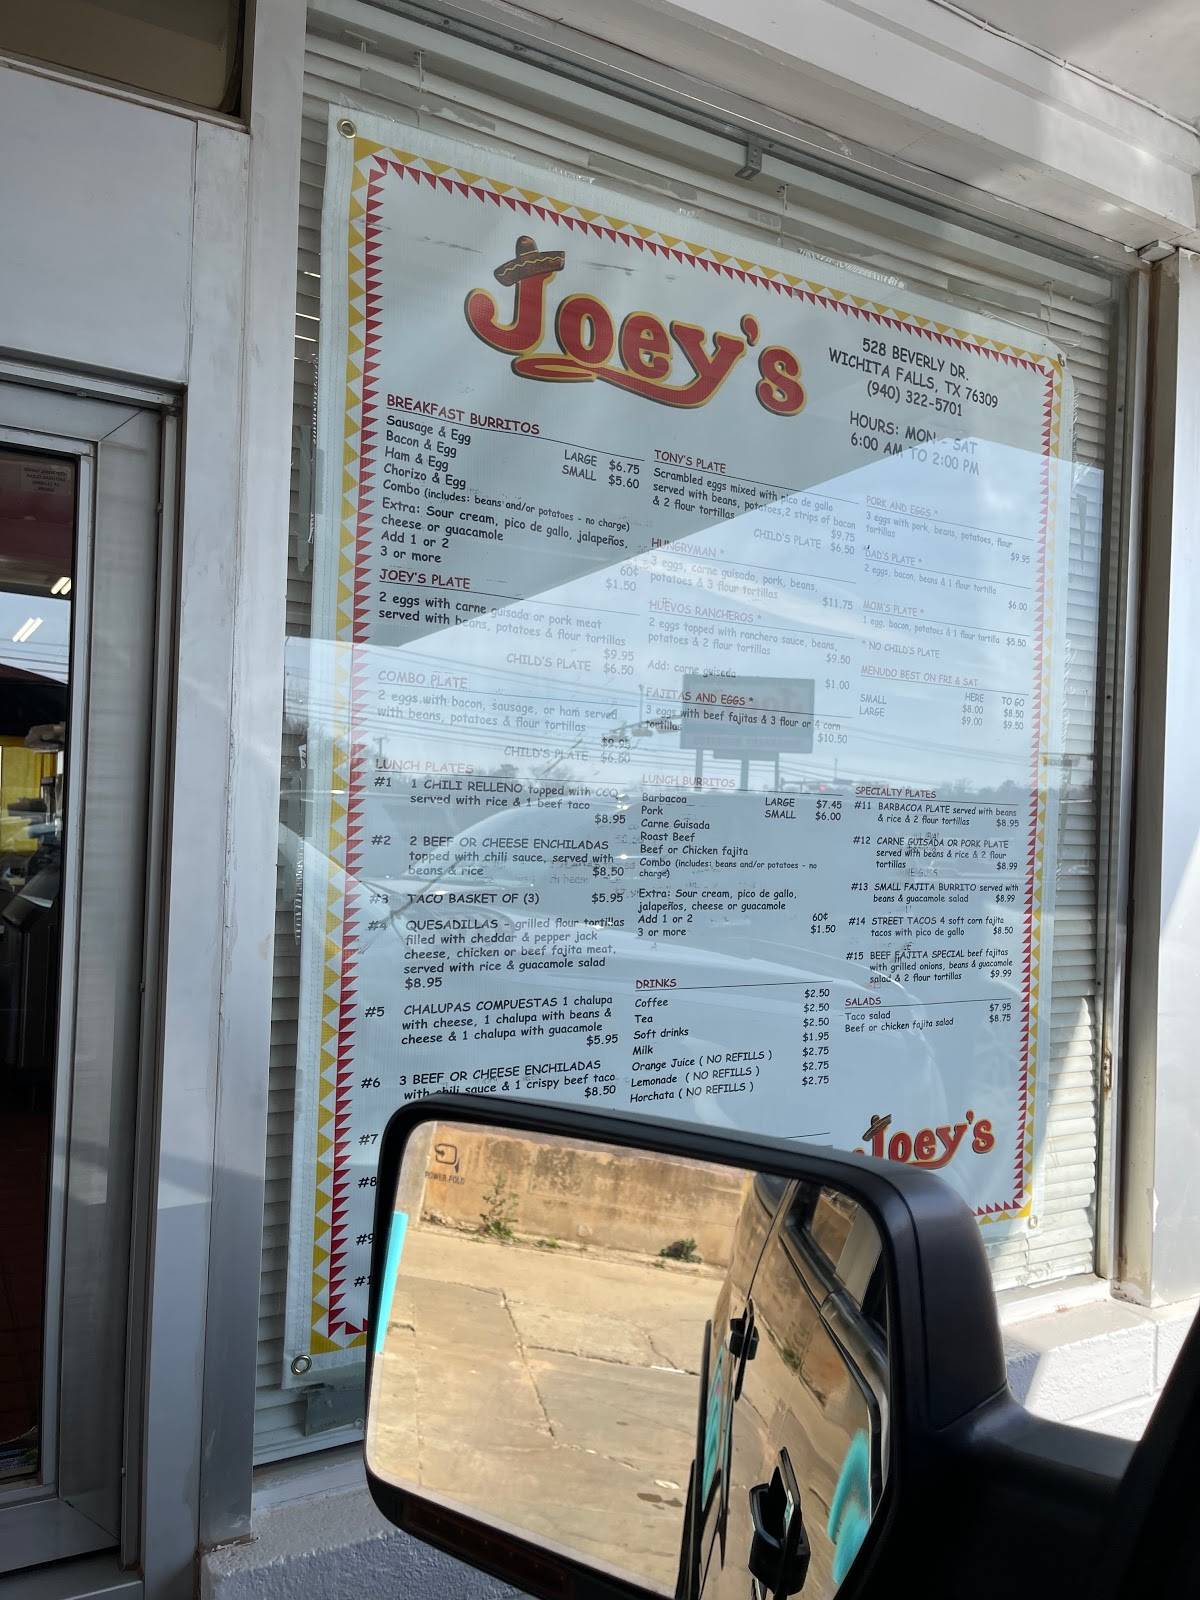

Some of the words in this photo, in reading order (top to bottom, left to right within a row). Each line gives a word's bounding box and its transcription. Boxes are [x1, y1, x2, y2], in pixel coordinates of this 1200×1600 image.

[463, 262, 807, 416] Joey's
[862, 337, 887, 357] 528
[892, 345, 946, 373] BEVERLY
[949, 361, 969, 381] DR.
[828, 346, 890, 379] WICHITA
[895, 366, 938, 394] FALLS,
[944, 380, 961, 398] TX
[965, 386, 999, 409] 76309
[867, 379, 901, 404] (940)
[905, 389, 962, 417] 322-5701
[386, 393, 466, 422] BREAKFAST
[469, 412, 542, 439] BURRITOS
[386, 414, 434, 437] Sausage
[437, 425, 447, 439] &
[450, 428, 472, 446] Egg
[849, 410, 899, 436] HOURS:
[904, 425, 937, 443] MON
[952, 437, 979, 456] SAT
[386, 430, 420, 448] Bacon
[423, 438, 432, 451] &
[436, 440, 457, 459] Egg
[850, 431, 879, 452] 6:00
[882, 441, 903, 458] AM
[908, 445, 928, 463] TO
[932, 451, 960, 470] 2:00
[962, 458, 980, 476] PM
[384, 445, 411, 463] Ham
[414, 452, 424, 465] &
[428, 454, 449, 473] Egg
[564, 449, 598, 467] LARGE
[608, 458, 640, 475] $6.75
[653, 449, 693, 467] TONY'S
[695, 457, 727, 474] PLATE
[383, 462, 427, 481] Chorizo
[431, 471, 440, 485] &
[445, 473, 467, 491] Egg
[561, 464, 597, 482] SMALL
[608, 473, 640, 490] $5.60
[653, 467, 704, 486] Scrambled
[706, 480, 727, 493] eggs
[730, 483, 757, 497] mixed
[759, 489, 778, 502] with
[780, 493, 798, 505] pico
[800, 496, 812, 508] de
[652, 495, 660, 507] &
[663, 497, 670, 508] 2
[674, 498, 696, 512] flour
[699, 504, 735, 520] tortillas
[380, 513, 422, 531] cheese
[426, 523, 441, 533] or
[445, 525, 504, 542] guacamole
[382, 496, 420, 514] Extra:
[425, 505, 455, 519] Sour
[459, 512, 499, 527] cream,
[504, 516, 526, 530] pico
[529, 520, 543, 533] de
[546, 525, 572, 541] gallo,
[576, 529, 628, 549] jalapeños,
[380, 529, 405, 544] Add
[410, 533, 417, 545] 1
[423, 538, 437, 547] or
[441, 537, 450, 549] 2
[380, 545, 388, 557] 3
[393, 550, 407, 559] or
[411, 551, 442, 564] more
[379, 568, 427, 584] JOEY'S
[431, 573, 471, 590] PLATE
[645, 686, 692, 702] FAJITAS
[695, 692, 718, 704] AND
[720, 693, 746, 706] EGGS
[859, 693, 888, 705] SMALL
[858, 704, 885, 718] LARGE
[641, 792, 687, 804] Barbacoa
[765, 796, 796, 808] LARGE
[816, 799, 843, 810] $7.45
[854, 786, 903, 798] SPECIALTY
[904, 788, 937, 799] PLATES
[640, 804, 664, 816] Pork
[764, 809, 797, 820] SMALL
[815, 810, 842, 822] $6.00
[854, 800, 872, 810] #11
[878, 801, 923, 813] BARBACOA
[925, 804, 951, 814] PLATE
[952, 806, 977, 815] served
[978, 807, 994, 816] with
[995, 807, 1017, 817] beans
[640, 818, 670, 829] Carne
[673, 818, 710, 830] Guisada
[370, 834, 392, 846] #2
[409, 835, 418, 846] 2
[423, 835, 454, 848] BEEF
[459, 836, 478, 848] OR
[481, 837, 529, 849] CHEESE
[533, 838, 609, 850] ENCHILADAS
[640, 830, 669, 841] Roast
[672, 831, 696, 843] Beef
[406, 893, 444, 906] TACO
[448, 892, 498, 904] BASKET
[501, 892, 519, 904] OF
[523, 892, 540, 905] (3)
[591, 891, 625, 905] $5.95
[635, 978, 677, 990] DRINKS
[364, 1006, 385, 1018] #5
[403, 1001, 472, 1016] CHALUPAS
[475, 997, 558, 1011] COMPUESTAS
[563, 996, 568, 1007] 1
[573, 994, 613, 1008] chalupa
[634, 996, 669, 1008] Coffee
[804, 988, 831, 999] $2.50
[844, 996, 882, 1007] SALADS
[634, 1014, 654, 1024] Tea
[803, 1002, 830, 1015] $2.50
[844, 1012, 866, 1021] Taco
[868, 1010, 891, 1020] salad
[988, 1002, 1012, 1013] $7.95
[632, 1028, 657, 1040] Soft
[660, 1026, 689, 1038] drinks
[802, 1016, 830, 1029] $2.50
[844, 1023, 866, 1033] Beef
[868, 1024, 878, 1032] or
[880, 1021, 910, 1031] chicken
[912, 1019, 933, 1031] fajita
[935, 1017, 954, 1027] salad
[989, 1013, 1012, 1024] $8.75
[632, 1044, 654, 1056] Milk
[802, 1031, 830, 1043] $1.95
[631, 1061, 667, 1073] Orange
[670, 1057, 696, 1069] Juice
[706, 1054, 723, 1065] NO
[725, 1050, 765, 1063] REFILLS
[802, 1045, 830, 1058] $2.75
[360, 1077, 381, 1089] #6
[399, 1075, 407, 1086] 3
[412, 1072, 445, 1085] BEEF
[449, 1070, 468, 1082] OR
[472, 1065, 520, 1081] CHEESE
[524, 1059, 601, 1076] ENCHILADAS
[584, 1084, 617, 1098] $8.50
[358, 1133, 379, 1146] #7
[357, 1176, 377, 1189] #8
